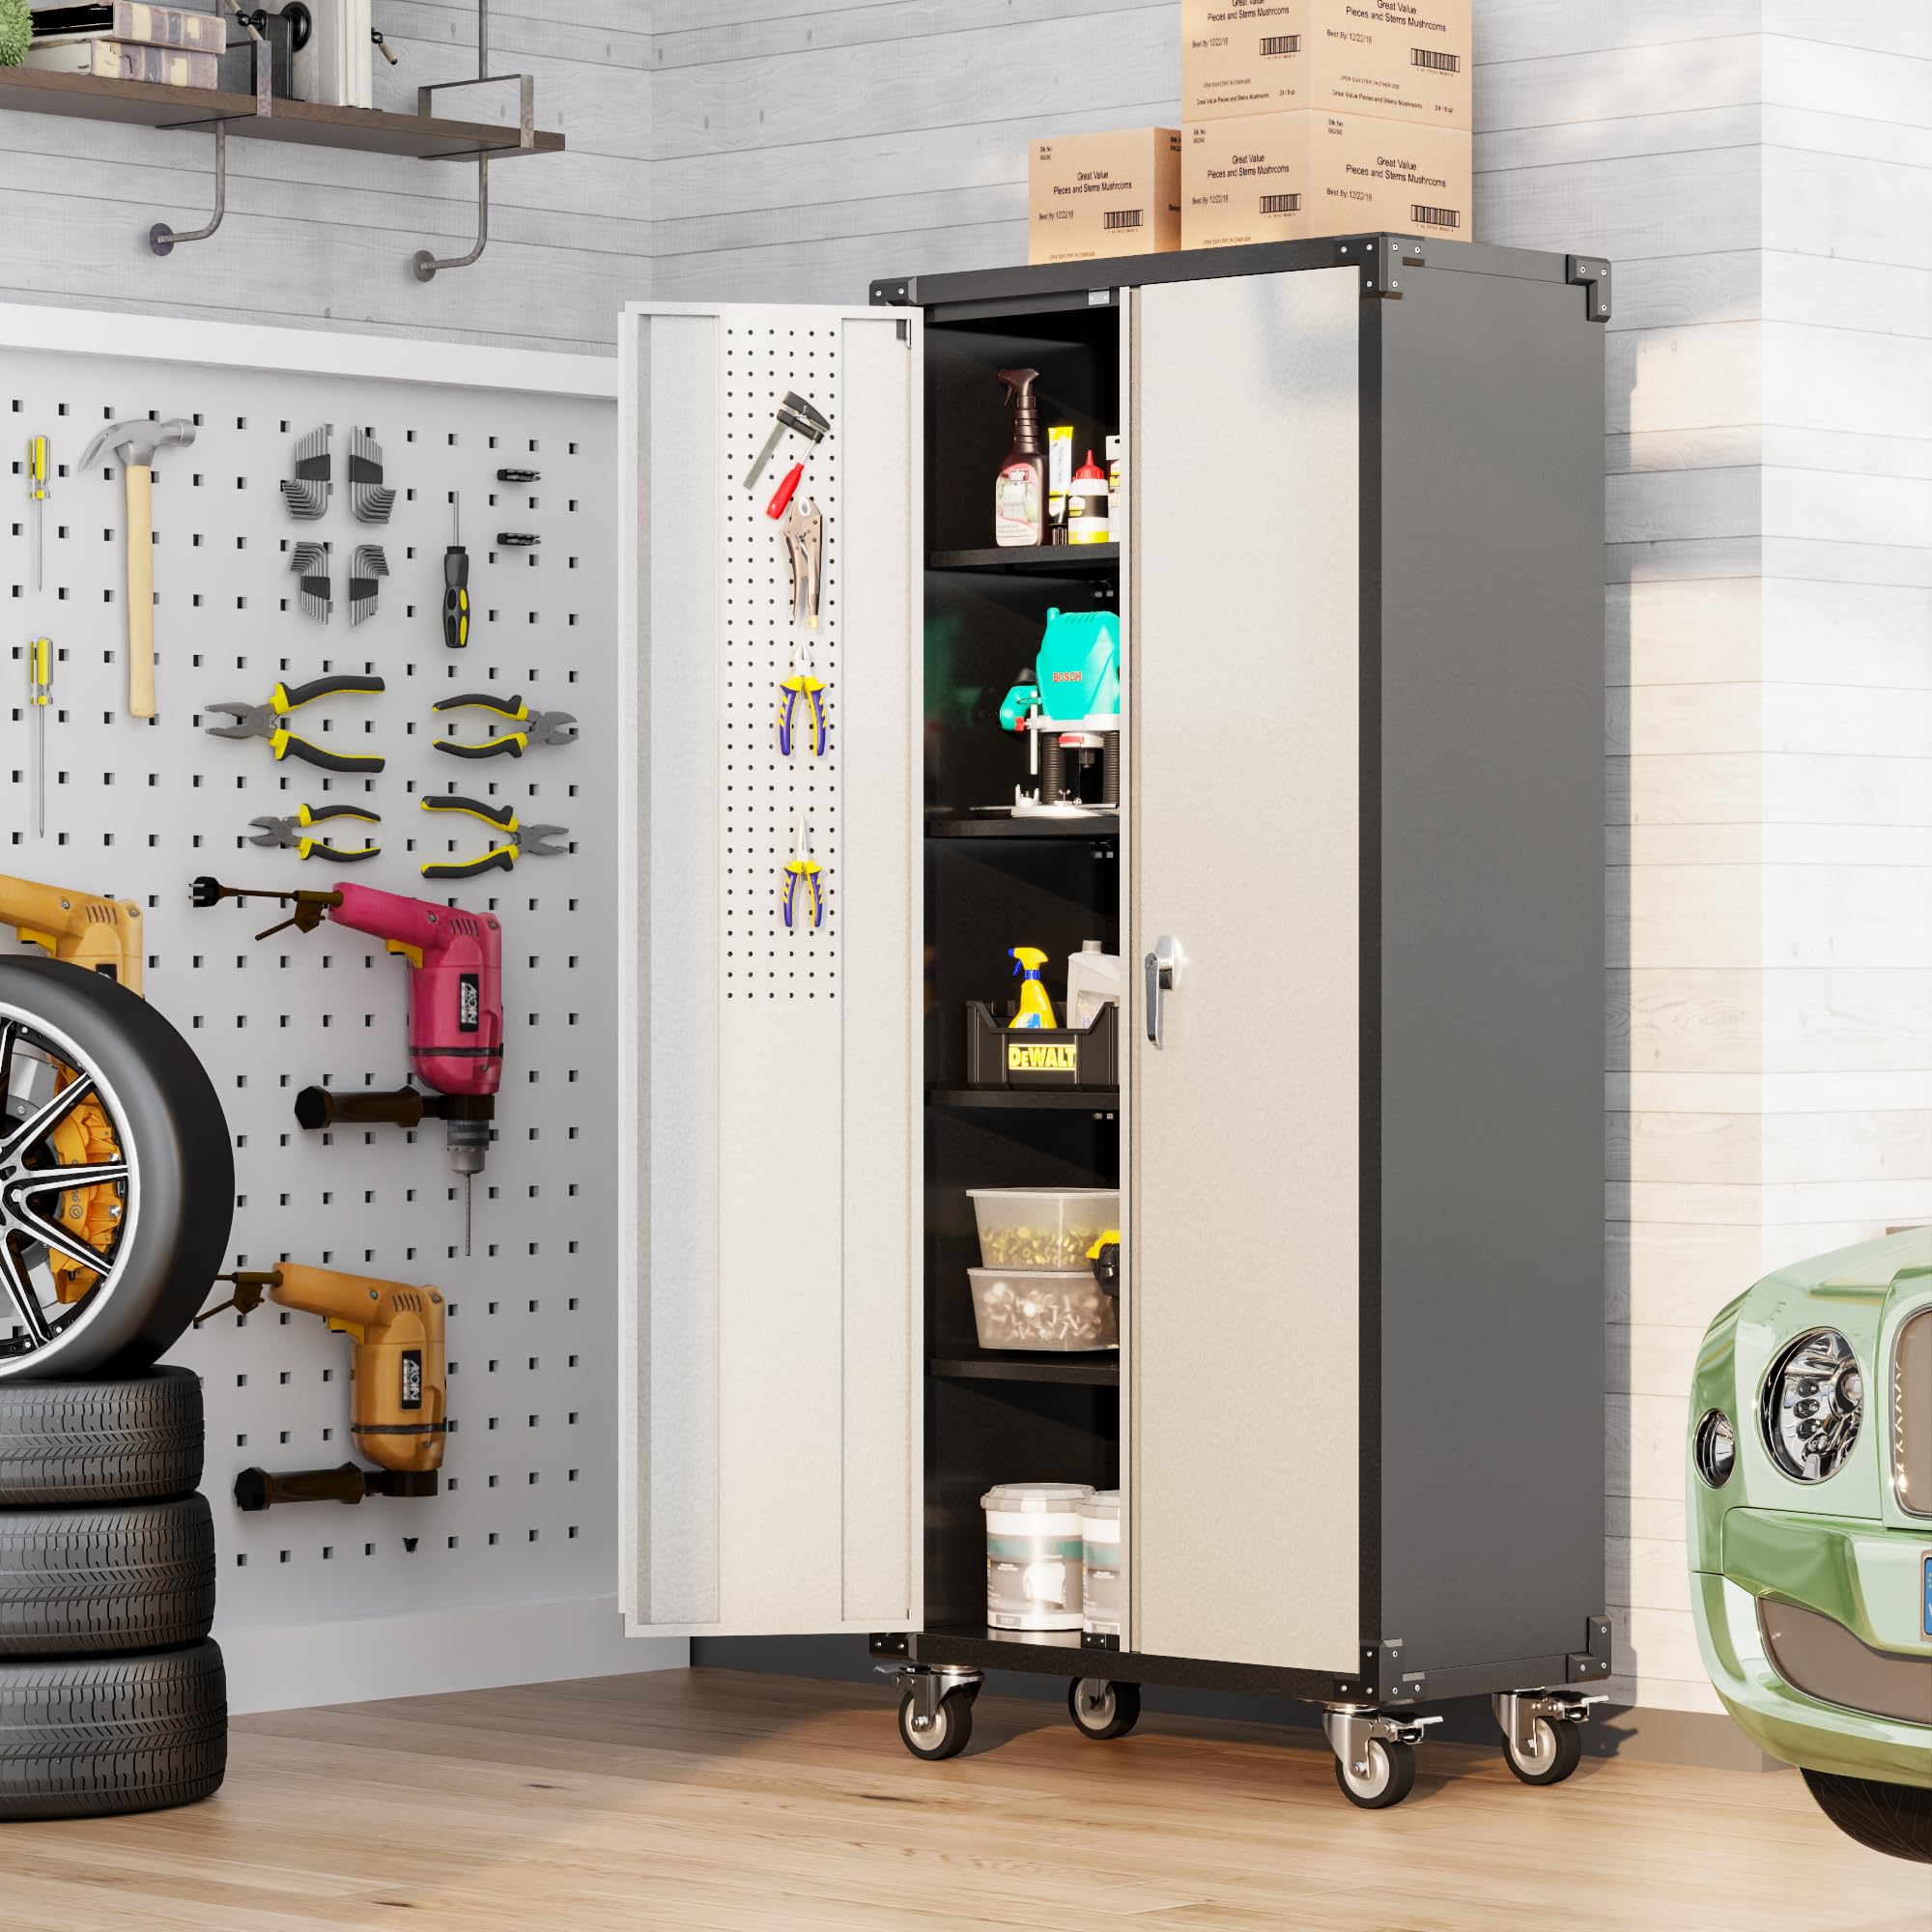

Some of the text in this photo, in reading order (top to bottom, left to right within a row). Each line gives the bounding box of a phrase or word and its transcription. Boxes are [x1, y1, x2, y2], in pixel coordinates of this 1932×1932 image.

[1238, 10, 1256, 18] Stems
[1258, 7, 1290, 16] Mushrooms
[1377, 0, 1417, 14] Great Value
[1347, 6, 1446, 31] Pieces and Stems Mushrooms
[1327, 29, 1339, 38] Best
[1233, 154, 1264, 164] Great Value
[1377, 156, 1417, 170] Great Value
[1077, 171, 1108, 181] Great Value
[1228, 168, 1236, 177] and
[1238, 166, 1256, 176] Stems
[1258, 164, 1290, 175] Mushrooms
[1347, 164, 1446, 187] Pieces and Stems Mushrooms
[1053, 182, 1132, 195] Pieces and Stems Mushrooms
[1053, 672, 1082, 682] BOSCH
